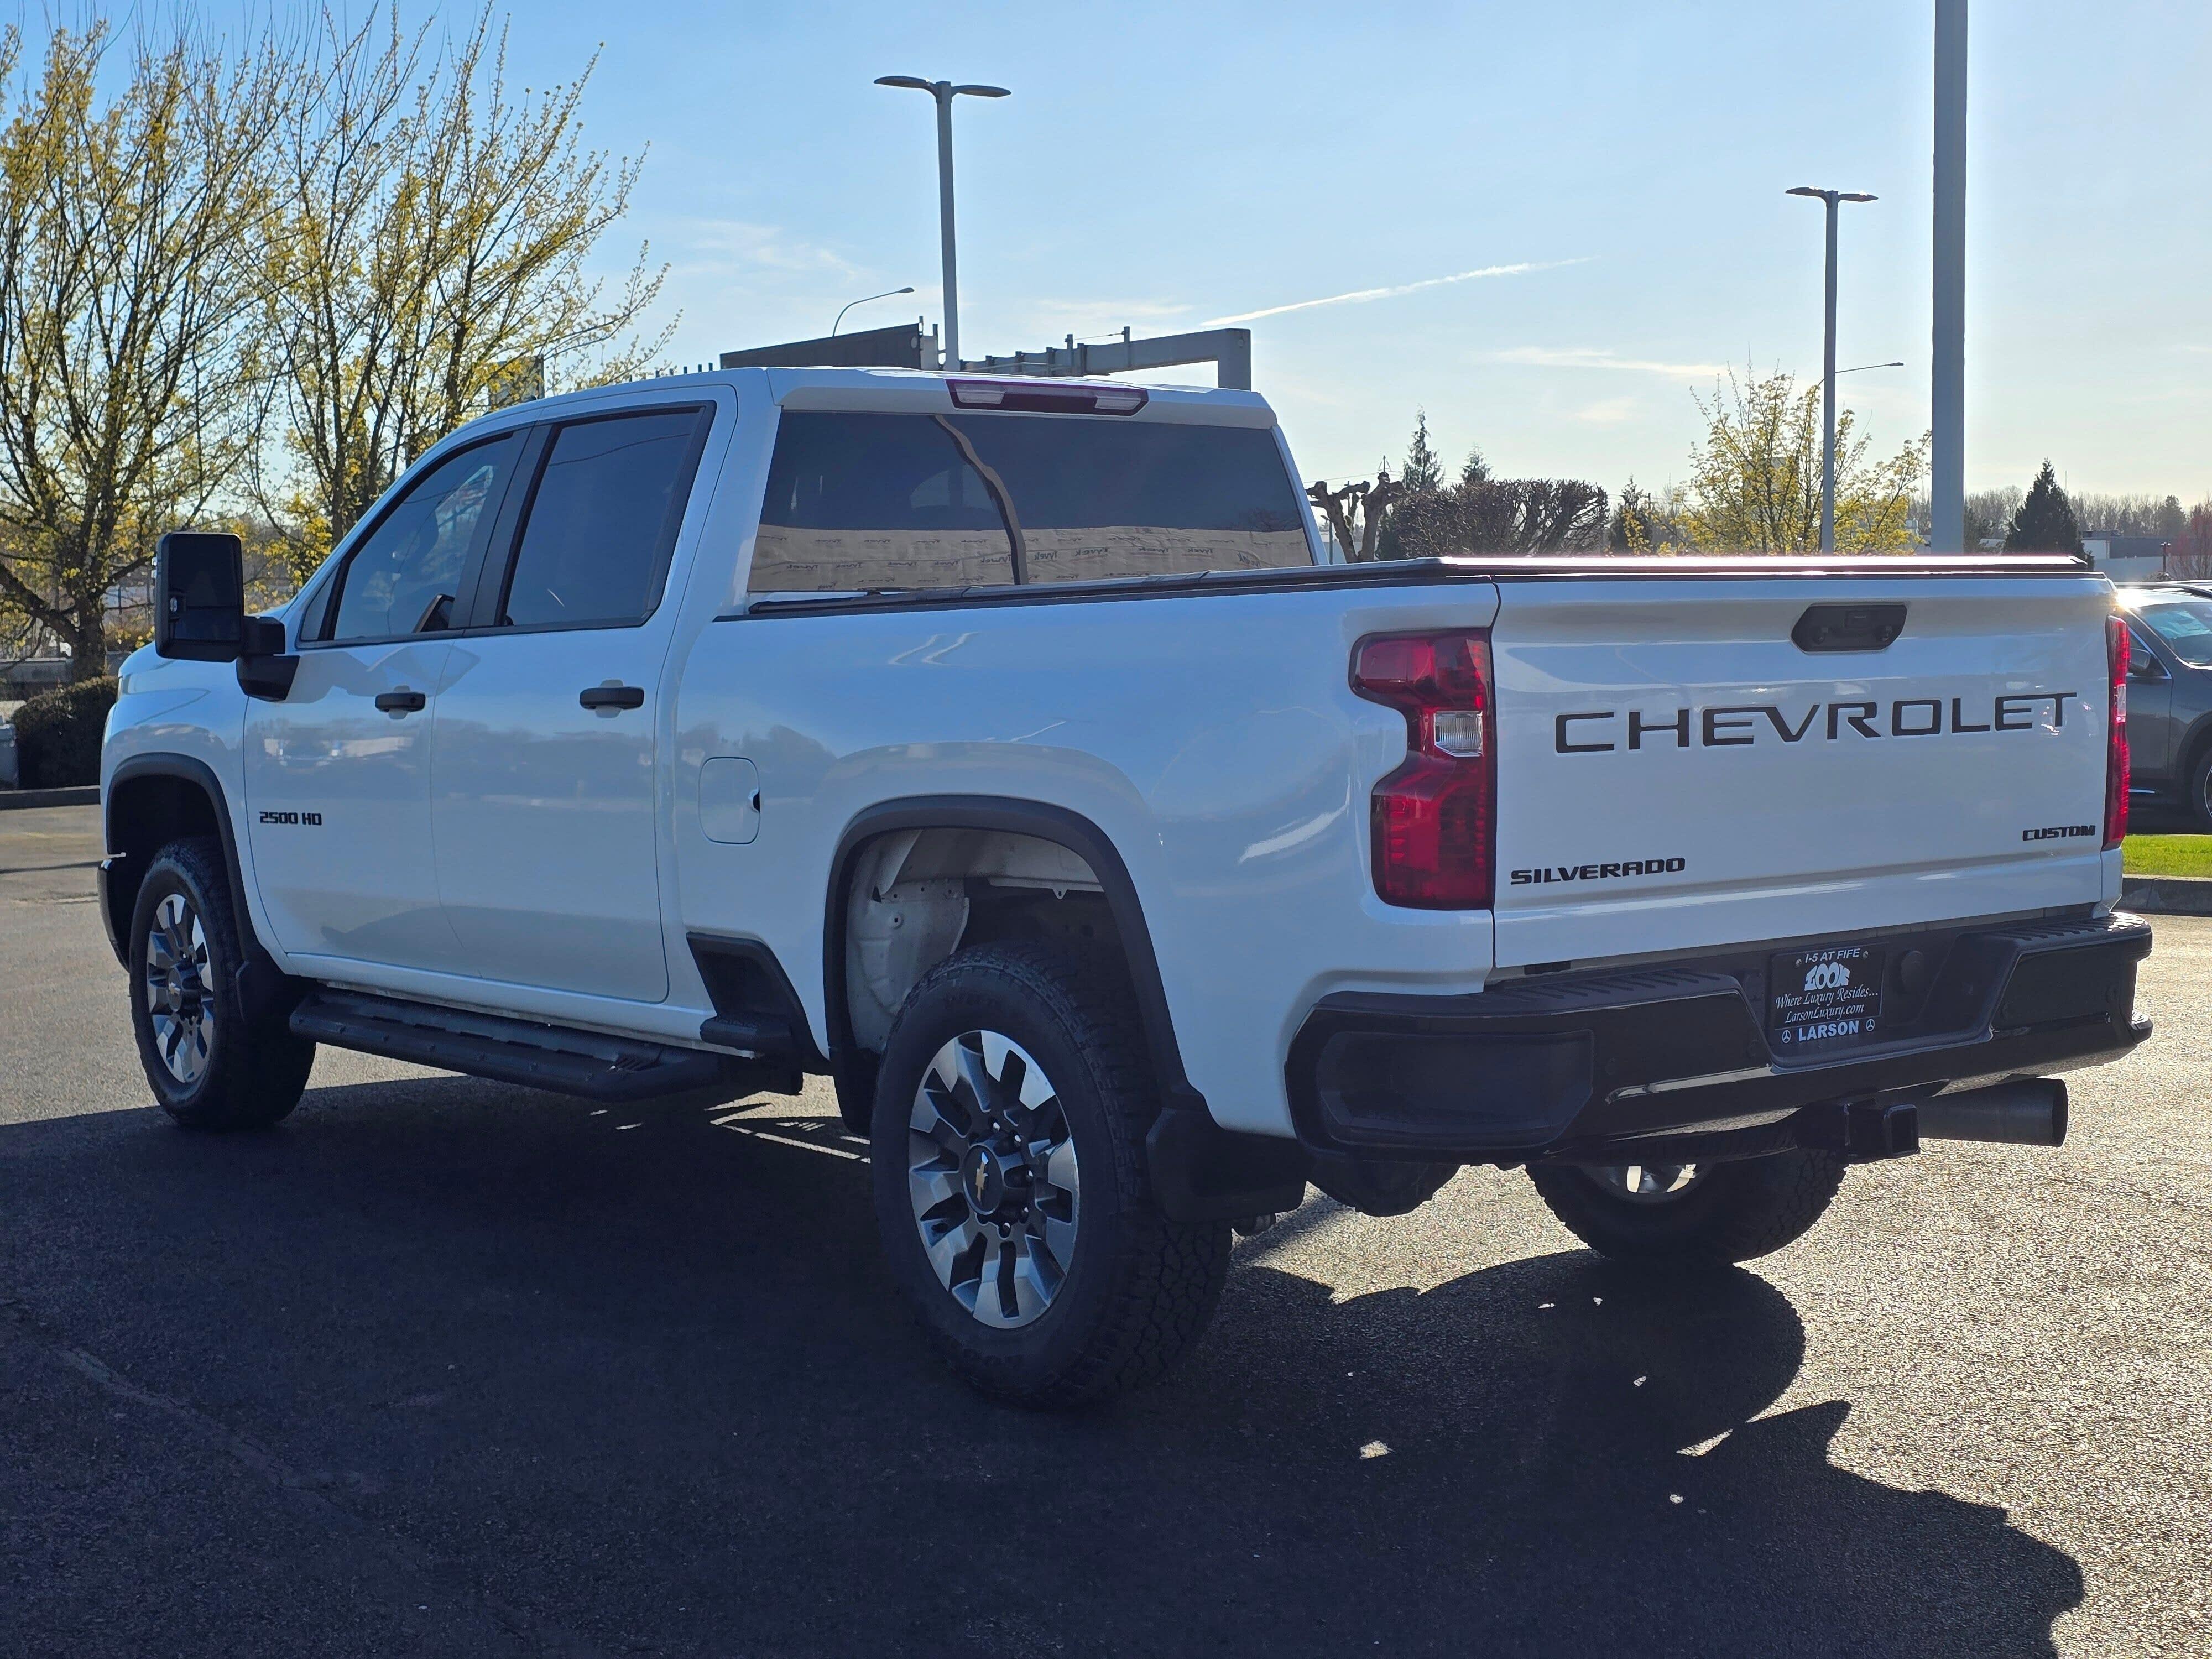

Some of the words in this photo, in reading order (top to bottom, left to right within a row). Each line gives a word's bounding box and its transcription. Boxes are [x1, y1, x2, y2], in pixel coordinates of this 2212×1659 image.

[1555, 692, 2077, 754] CHEVROLET
[259, 811, 298, 825] 2500
[302, 812, 322, 826] HD
[2022, 825, 2096, 841] CUSTOM
[1510, 857, 1686, 885] SILVERADO
[1804, 953, 1819, 963] I-5
[1819, 951, 1835, 962] AT
[1837, 948, 1861, 959] FIFE
[1775, 993, 1802, 1009] Where
[1803, 992, 1835, 1006] Luxury
[1835, 984, 1879, 1002] Resides...
[1785, 1004, 1865, 1024] LarsonLuxury.com
[1798, 1020, 1859, 1041] LARSON
